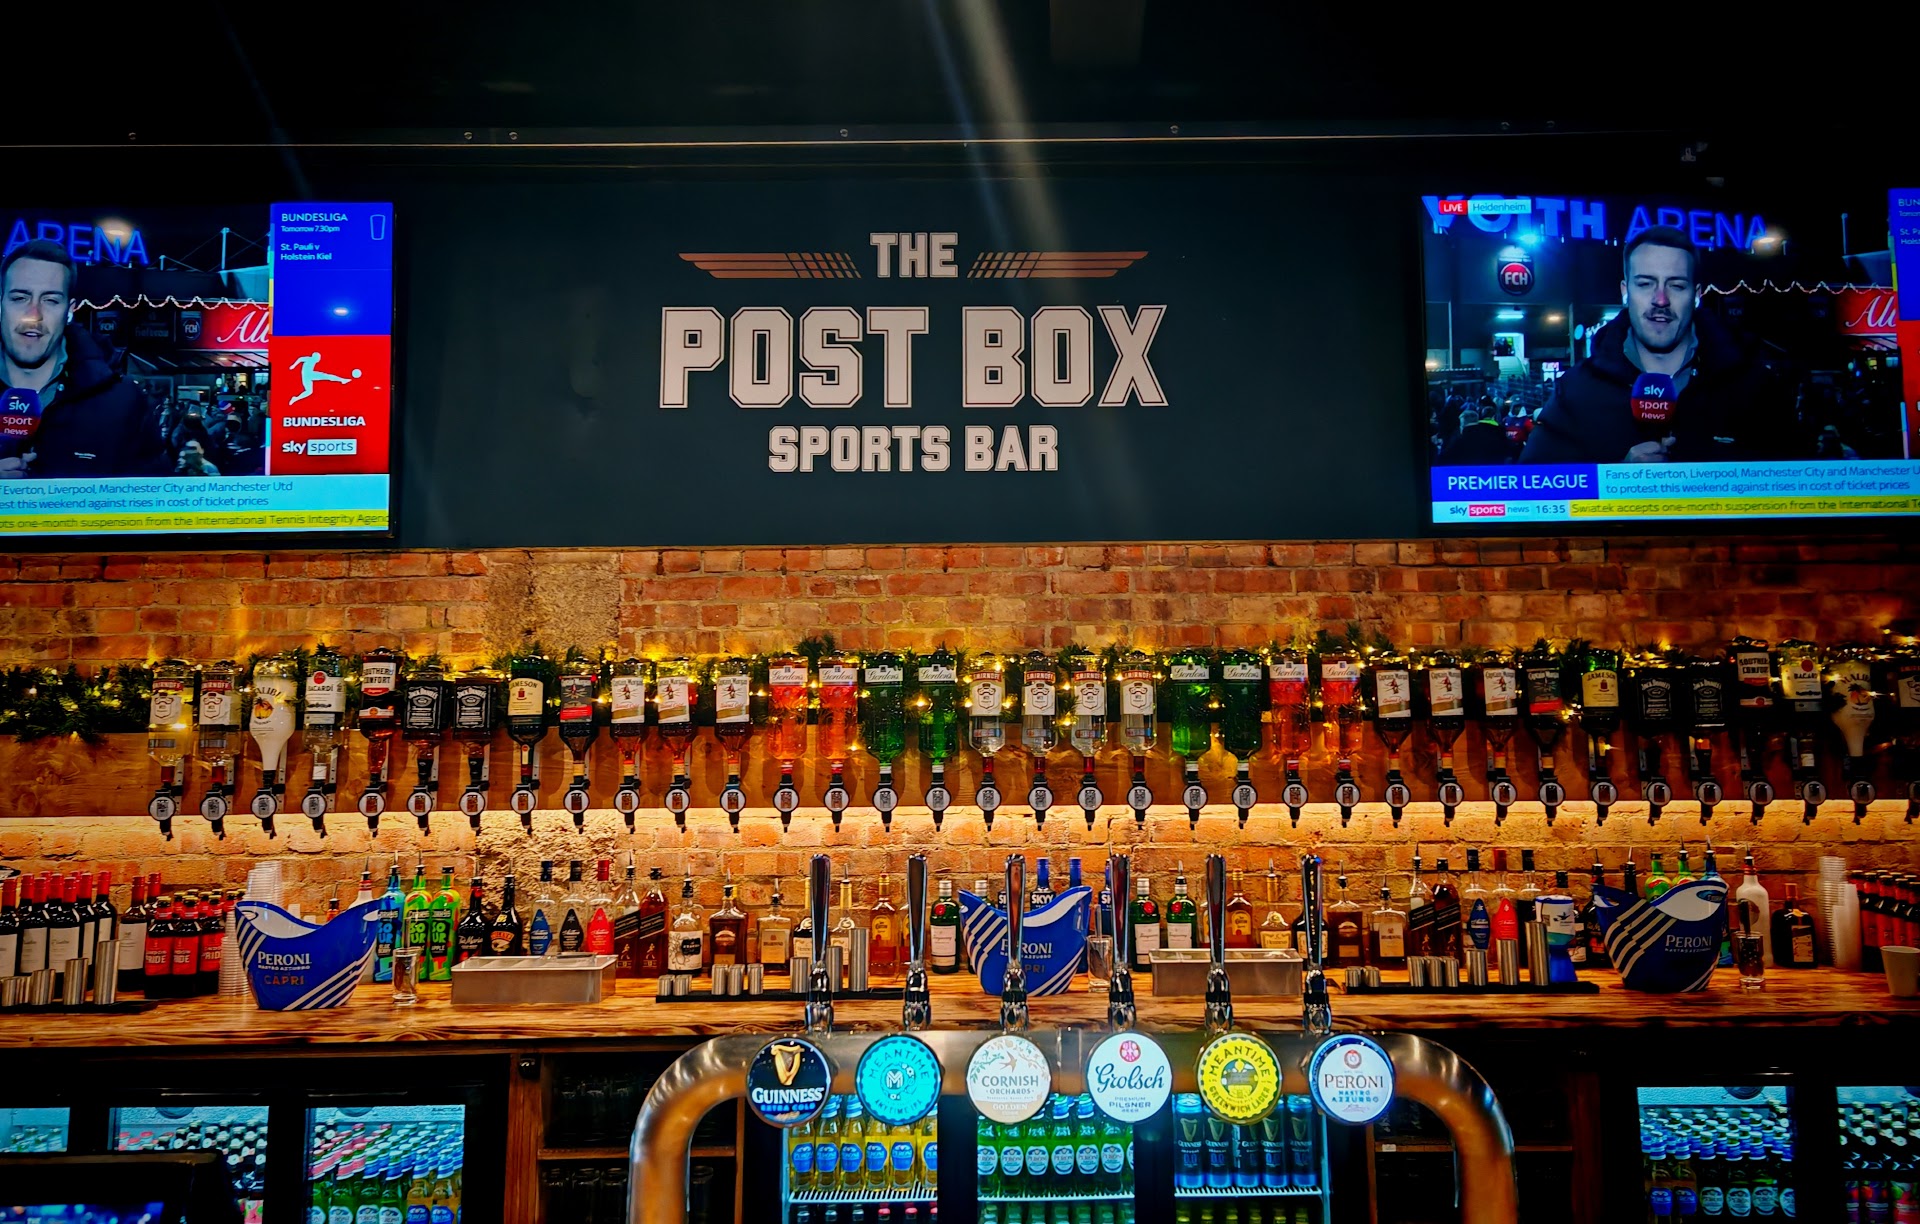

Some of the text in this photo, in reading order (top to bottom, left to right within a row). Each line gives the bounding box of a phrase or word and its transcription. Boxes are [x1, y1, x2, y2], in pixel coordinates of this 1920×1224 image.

[1444, 202, 1527, 212] LIVE Heidenheim
[281, 213, 348, 222] BUNDESLIGA
[281, 243, 293, 251] St.
[293, 243, 313, 251] Pauli
[870, 232, 958, 278] THE
[1504, 272, 1528, 285] FCH
[184, 323, 198, 334] FCH
[660, 305, 1169, 408] POST BOX
[1643, 385, 1665, 398] sky
[9, 400, 30, 413] sky
[1639, 401, 1669, 411] sport
[3, 416, 32, 426] sport
[282, 416, 366, 427] BUNDESLIGA
[1641, 412, 1666, 420] news
[4, 428, 29, 436] news
[282, 440, 354, 454] sky sports
[768, 425, 1059, 472] SPORTS BAR
[1606, 470, 1630, 479] Fans
[1632, 469, 1643, 479] of
[1646, 469, 1688, 480] Everton,
[1690, 468, 1739, 480] Liverpool,
[1741, 467, 1803, 477] Manchester
[1804, 467, 1825, 478] City
[1827, 466, 1847, 476] and
[1850, 466, 1911, 476] Manchester
[3, 481, 293, 496] Everton, Liverpool, Manchester City and Manchester Utd
[1448, 474, 1588, 490] PREMIER LEAGUE
[1606, 480, 1910, 495] to protest this weekend against rises in cost of ticket prices
[17, 496, 269, 510] this weekend against rises in cost of ticket prices
[1450, 504, 1566, 516] sky sports news 16:35
[1572, 503, 1614, 513] Swiatek
[1617, 503, 1660, 515] accepts
[1662, 502, 1723, 512] one-month
[1725, 501, 1788, 513] suspension
[1789, 500, 1816, 510] from
[1817, 500, 1836, 510] the
[18, 517, 77, 528] one-month
[81, 515, 142, 528] suspension
[145, 516, 171, 526] from
[174, 515, 193, 526] the
[196, 515, 267, 526] International
[269, 515, 305, 525] Tennis
[308, 513, 354, 527] Integrity
[1026, 672, 1054, 682] SMIRNOFF
[1031, 894, 1054, 904] SKYY
[1001, 938, 1052, 954] PRONI
[1665, 934, 1712, 948] PERONI
[257, 951, 311, 966] PERONI
[263, 975, 304, 985] CAPRI
[869, 1049, 930, 1079] MEANTIME
[1209, 1046, 1270, 1076] MEANTIME
[981, 1075, 1039, 1087] CORNISH
[1095, 1063, 1165, 1093] Grolsch
[1324, 1073, 1384, 1088] PERONI
[752, 1087, 825, 1104] GUINNESS
[1209, 1086, 1270, 1113] GREENWICH LAGER
[760, 1102, 816, 1112] EXTRA COLD
[874, 1099, 908, 1115] ANYTIME
